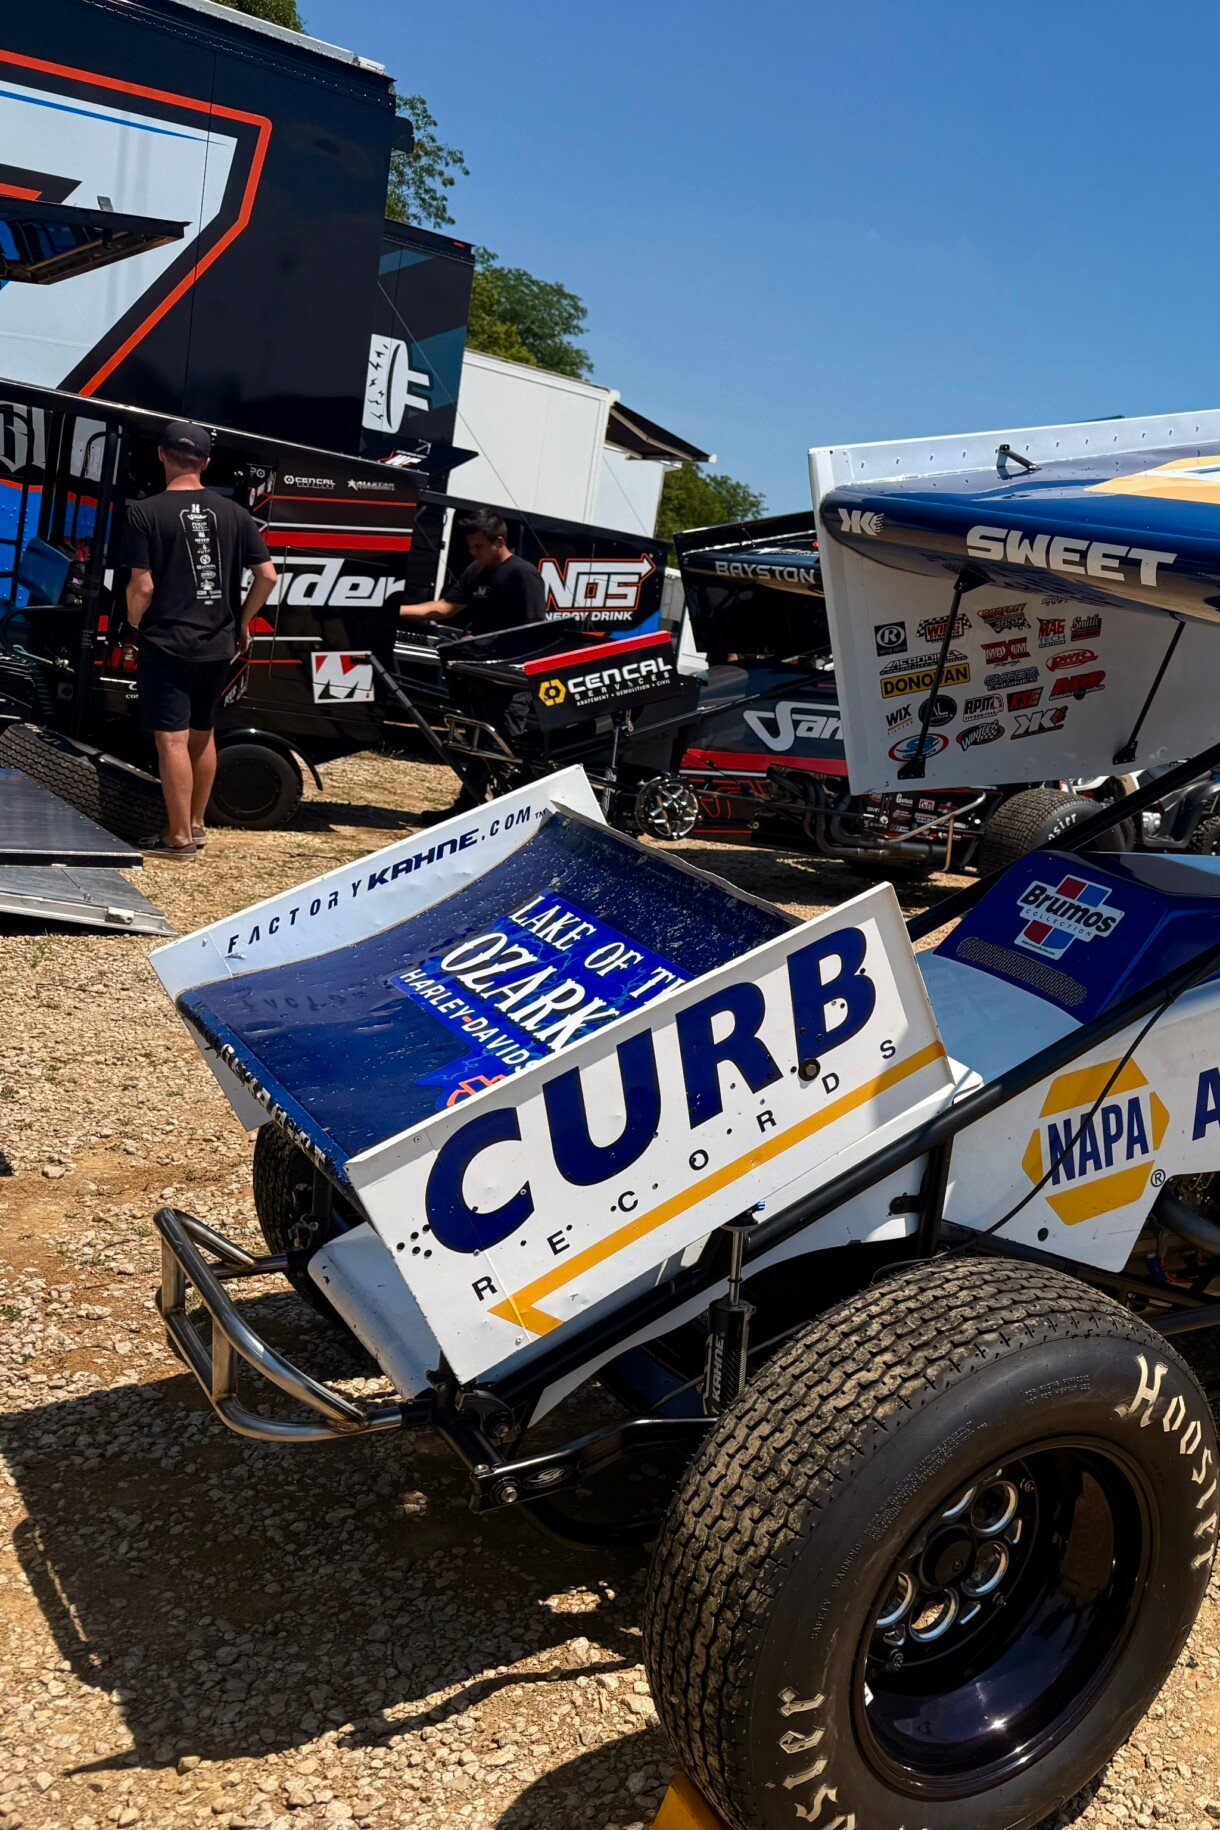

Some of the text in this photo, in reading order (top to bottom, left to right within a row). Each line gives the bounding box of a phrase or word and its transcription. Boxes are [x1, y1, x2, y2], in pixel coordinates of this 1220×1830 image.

[540, 553, 656, 611] NOS
[714, 560, 816, 584] BAYSTON
[967, 525, 1177, 587] SWEET
[591, 611, 634, 621] DRINK
[567, 657, 673, 694] CENCAL
[574, 671, 671, 701] SERVICES
[886, 703, 913, 727] WIX
[508, 895, 597, 951] LAKE
[584, 941, 645, 977] OF
[1019, 883, 1117, 933] Brumos
[1025, 908, 1092, 937] COLLECTION
[400, 968, 547, 1075] HARLEY-DAVIDS
[440, 932, 620, 1055] OZARK
[424, 926, 877, 1255] CURB
[472, 1039, 898, 1302] RECORDS
[1047, 1096, 1150, 1186] NAPA
[711, 1334, 724, 1402] KAHNE
